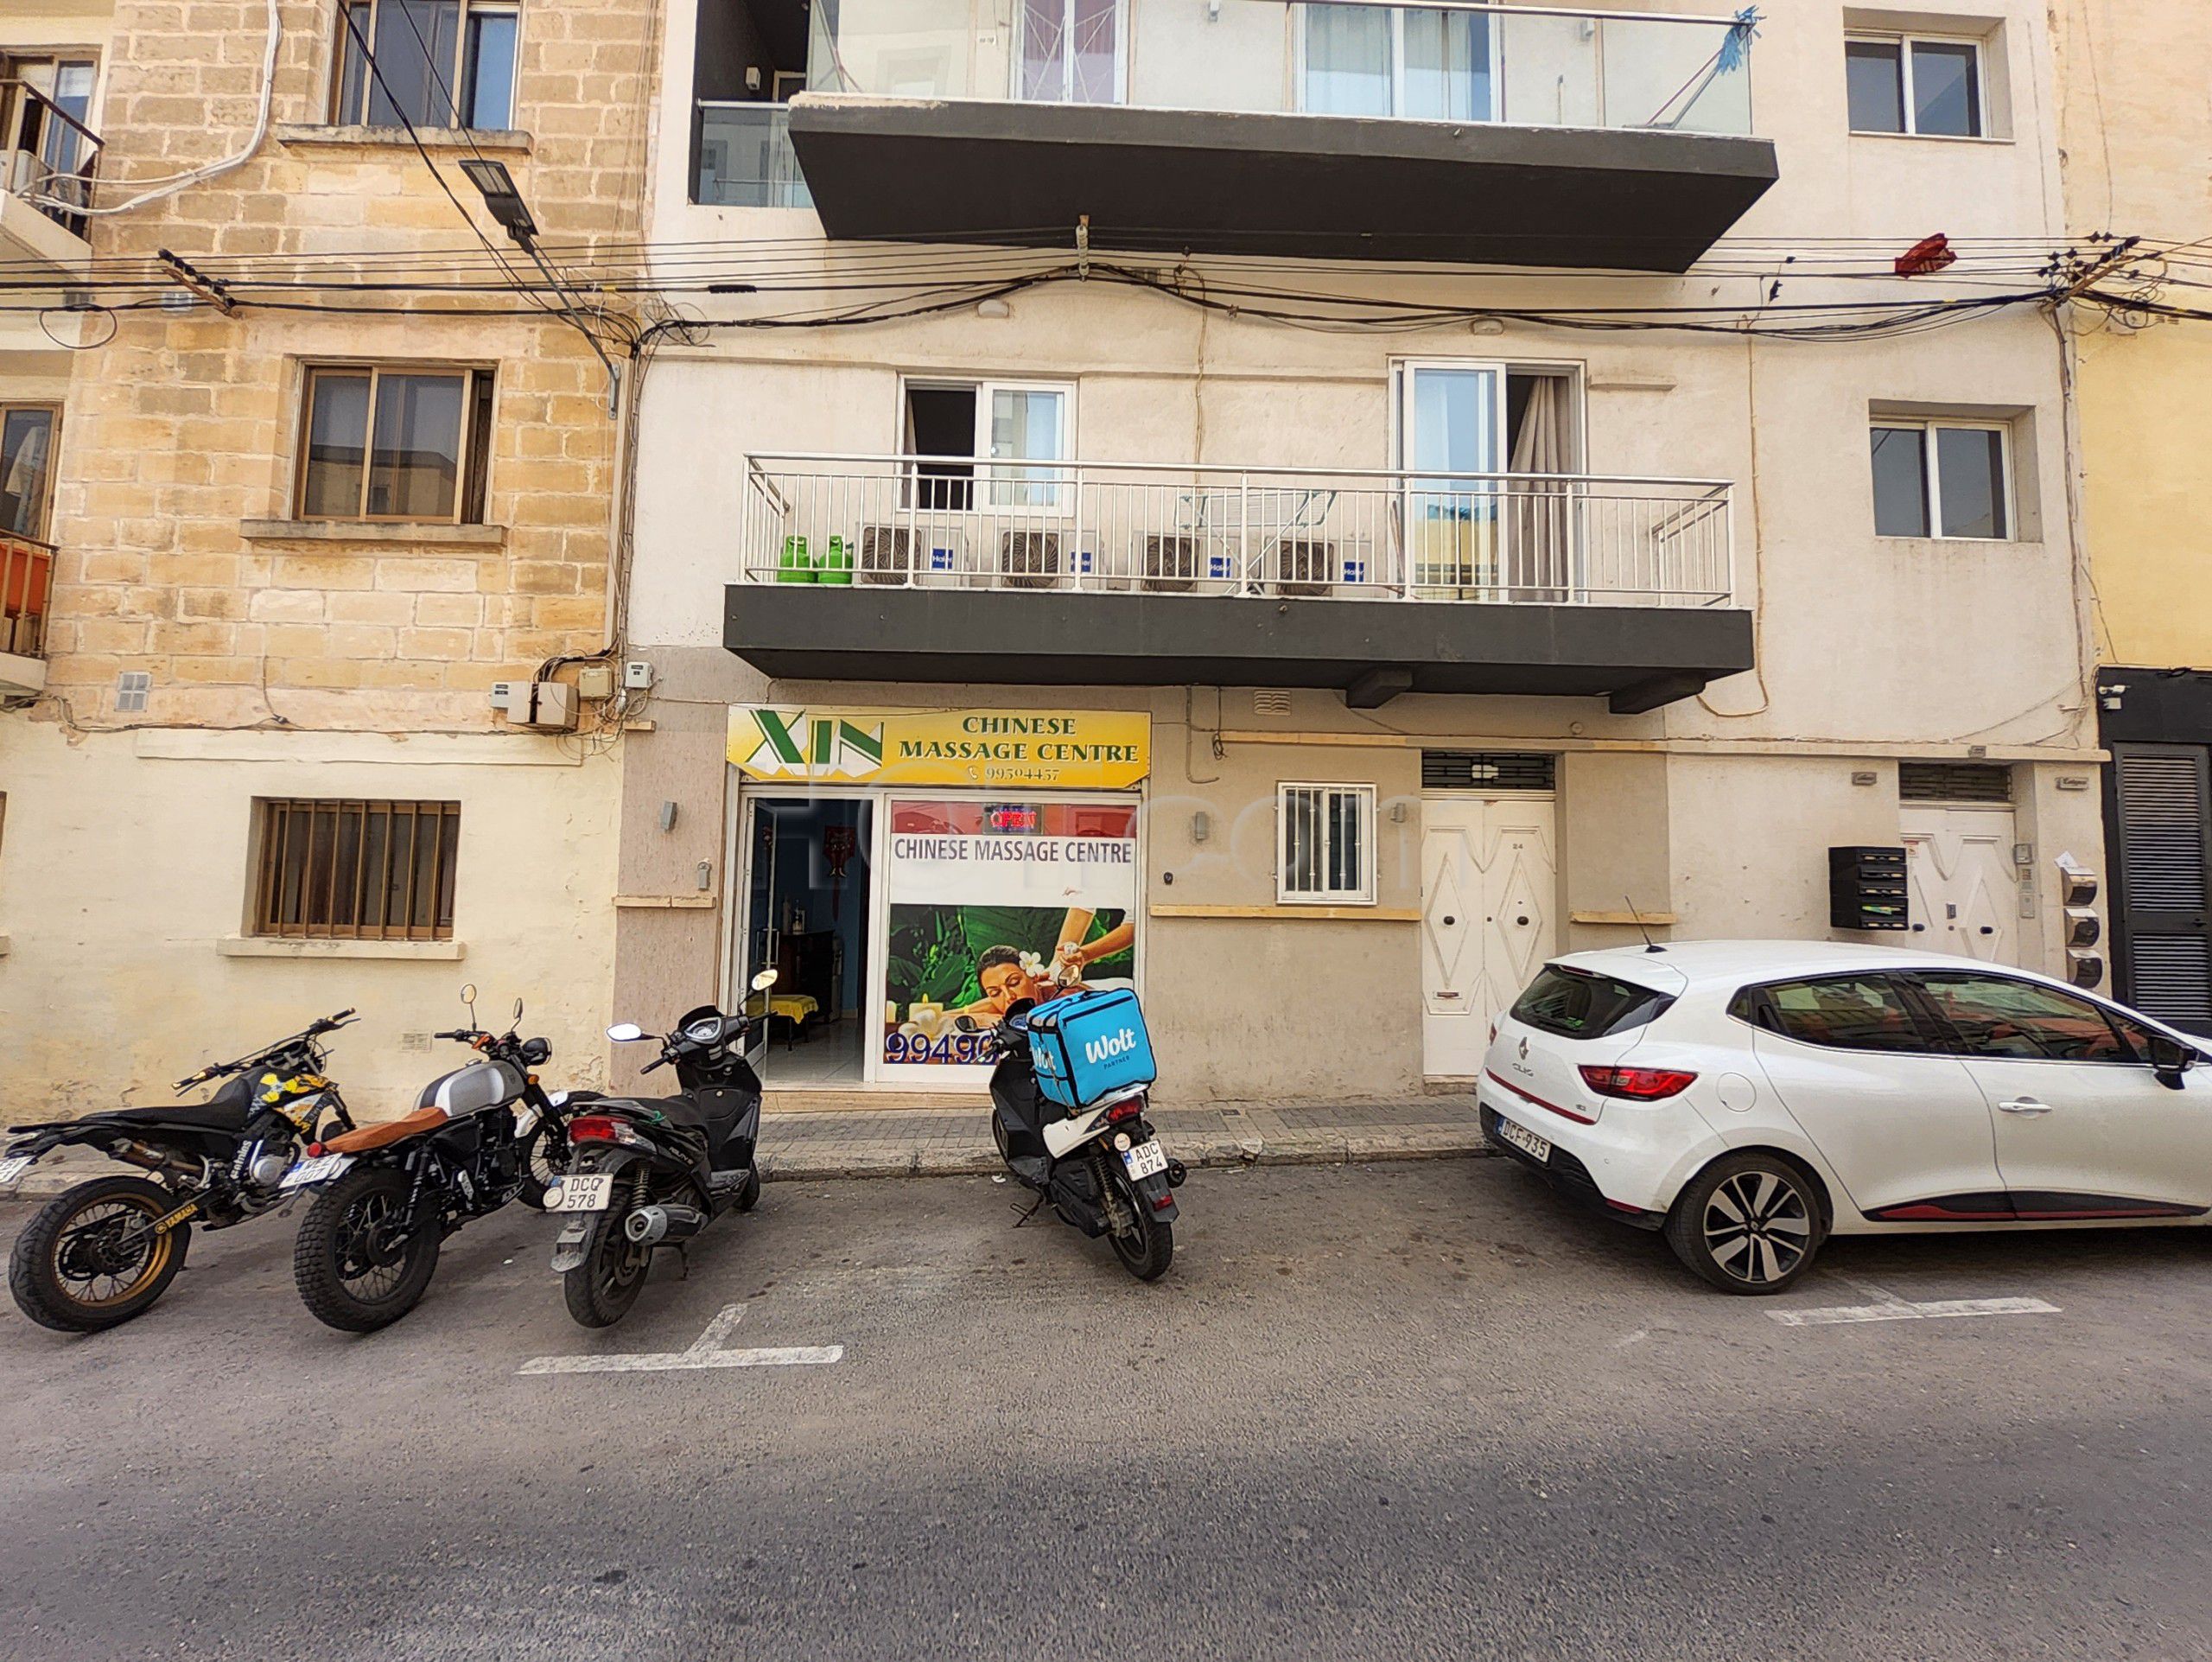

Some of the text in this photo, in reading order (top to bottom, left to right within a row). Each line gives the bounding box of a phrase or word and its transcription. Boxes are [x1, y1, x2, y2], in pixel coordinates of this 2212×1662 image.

[962, 716, 1077, 735] CHINESE
[745, 709, 884, 769] XIN
[899, 741, 1140, 762] MASSAGE CENTRE
[989, 811, 1038, 828] OPEN
[894, 838, 1132, 863] CHINESE MASSAGE CENTRE
[1085, 1028, 1137, 1064] Wolt
[1135, 1143, 1159, 1162] ADC
[1524, 1133, 1548, 1158] 935
[1140, 1156, 1163, 1175] 874
[567, 1194, 596, 1208] 578
